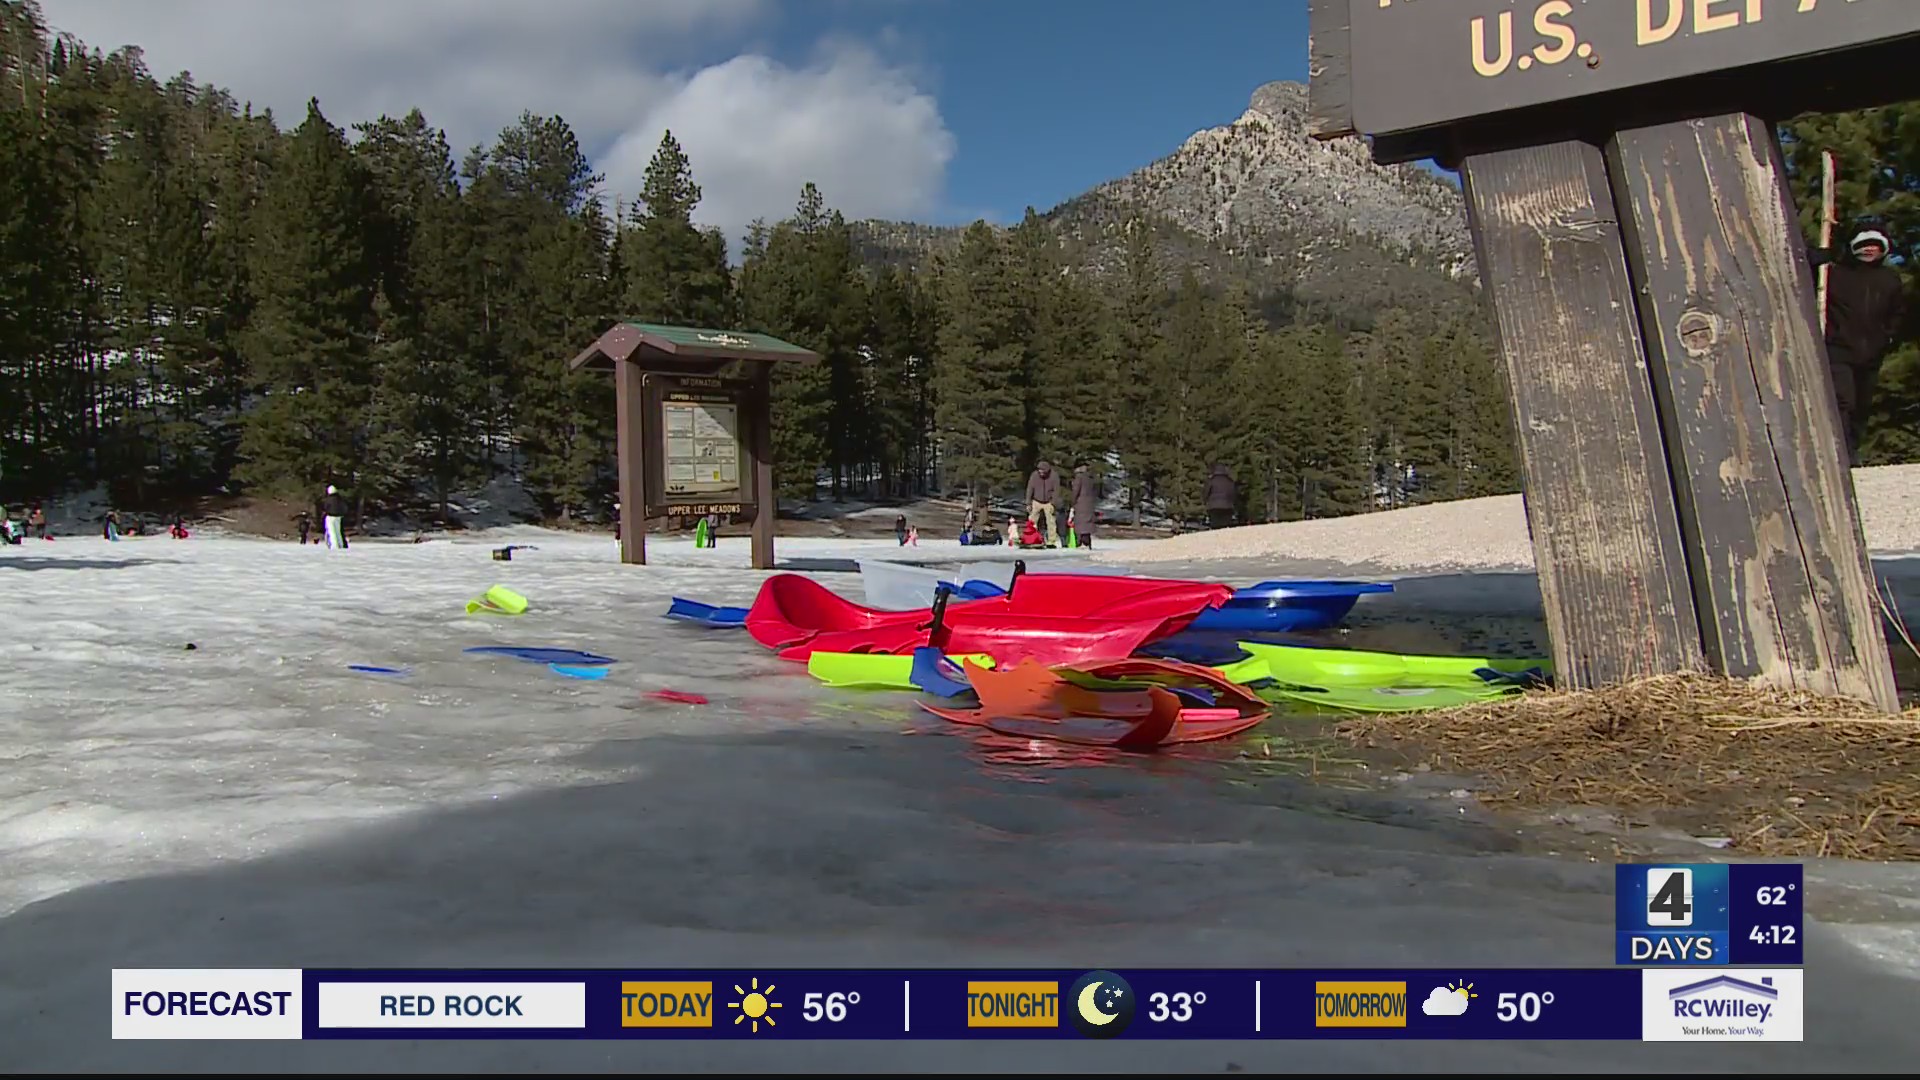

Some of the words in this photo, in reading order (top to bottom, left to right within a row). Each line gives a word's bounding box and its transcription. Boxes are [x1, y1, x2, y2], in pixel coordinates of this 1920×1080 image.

[1471, 0, 1592, 77] U.S.
[680, 377, 721, 388] INFORMATION
[668, 505, 691, 516] UPPER
[694, 505, 707, 515] LEE
[709, 504, 741, 515] MEADOWS
